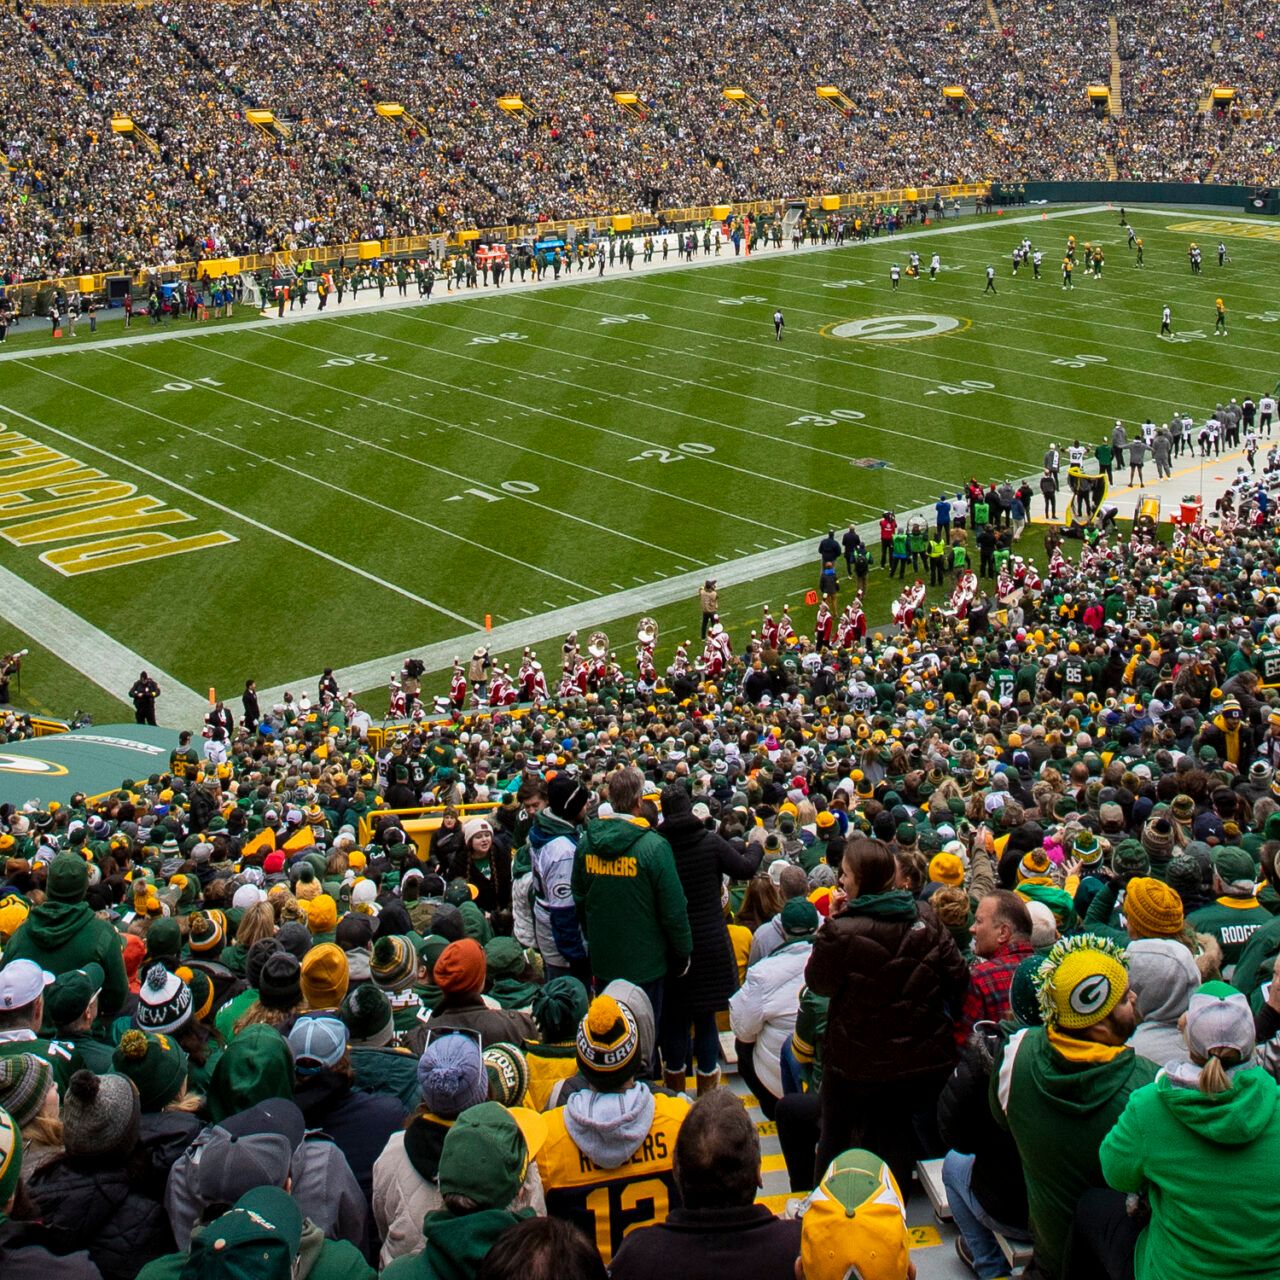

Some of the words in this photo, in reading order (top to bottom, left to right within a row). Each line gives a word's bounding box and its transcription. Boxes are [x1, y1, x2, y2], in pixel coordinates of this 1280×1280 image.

[472, 331, 529, 346] 30
[325, 352, 389, 368] 20
[1050, 354, 1109, 368] 50
[161, 376, 225, 392] 10
[937, 379, 996, 397] 40
[797, 408, 866, 428] 30
[640, 441, 716, 464] 20
[1071, 452, 1083, 461] 67
[466, 480, 540, 504] 10
[999, 680, 1015, 698] 12
[585, 853, 638, 877] PACKERS
[1070, 975, 1111, 1014] G
[580, 1132, 668, 1173] RERS
